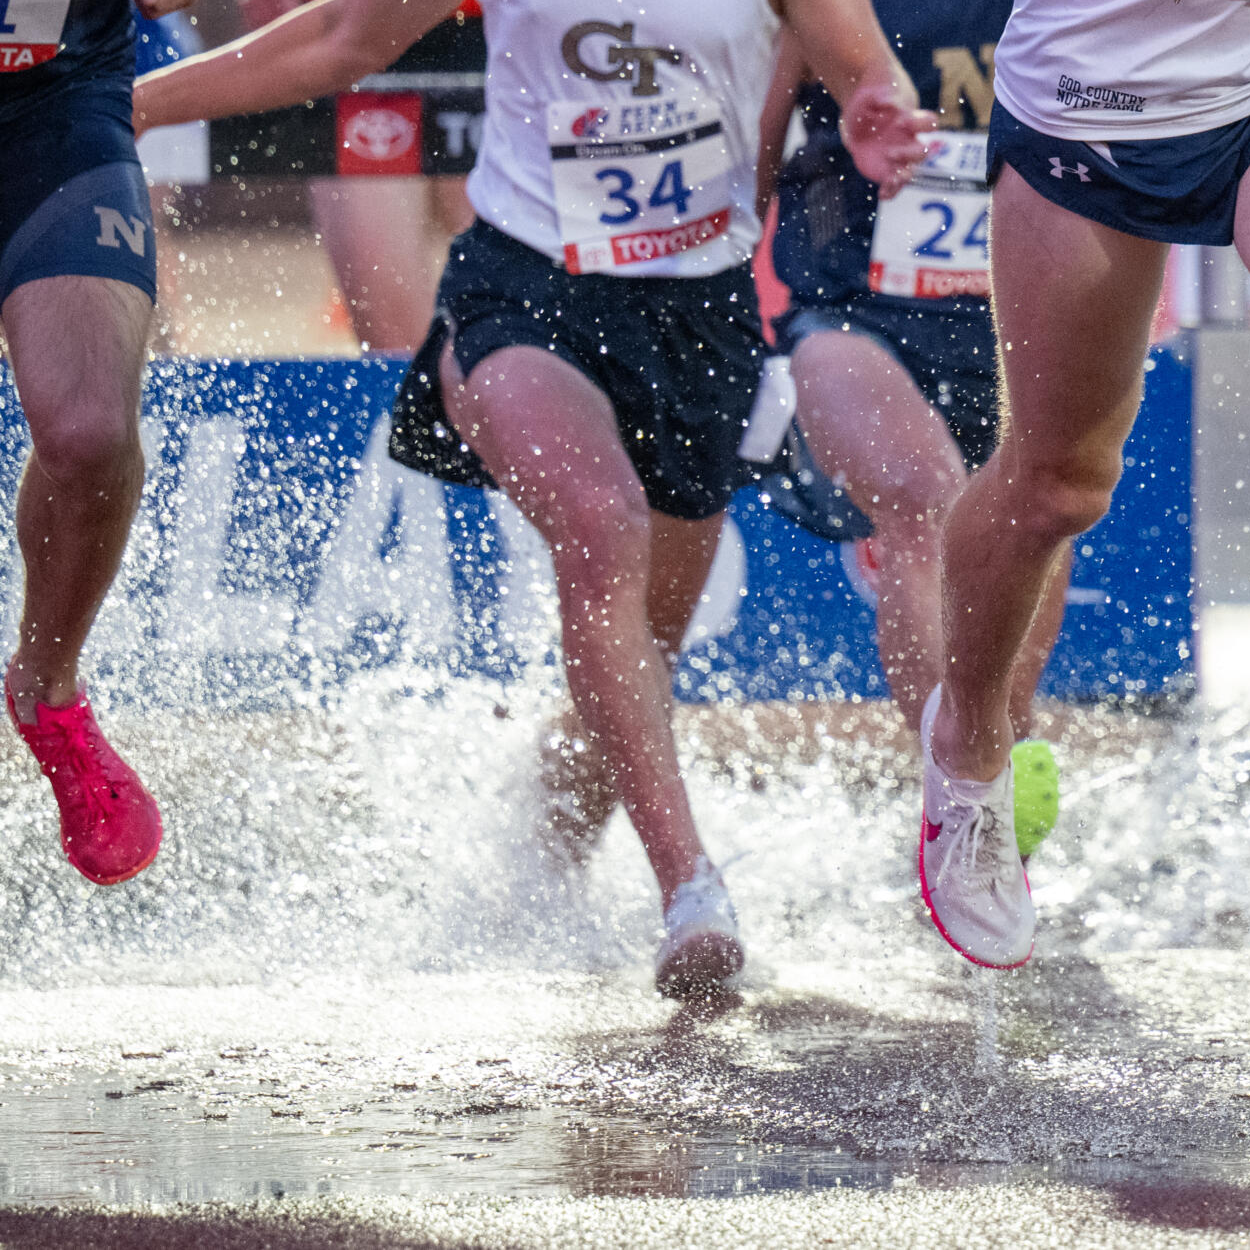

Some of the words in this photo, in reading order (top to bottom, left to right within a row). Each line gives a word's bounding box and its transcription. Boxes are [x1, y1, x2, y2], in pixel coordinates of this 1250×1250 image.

[561, 20, 684, 97] GT
[1086, 86, 1147, 105] COUNTRY
[595, 160, 693, 226] 34
[94, 206, 148, 258] N
[614, 218, 721, 261] TOYOTA
[914, 201, 989, 259] 24
